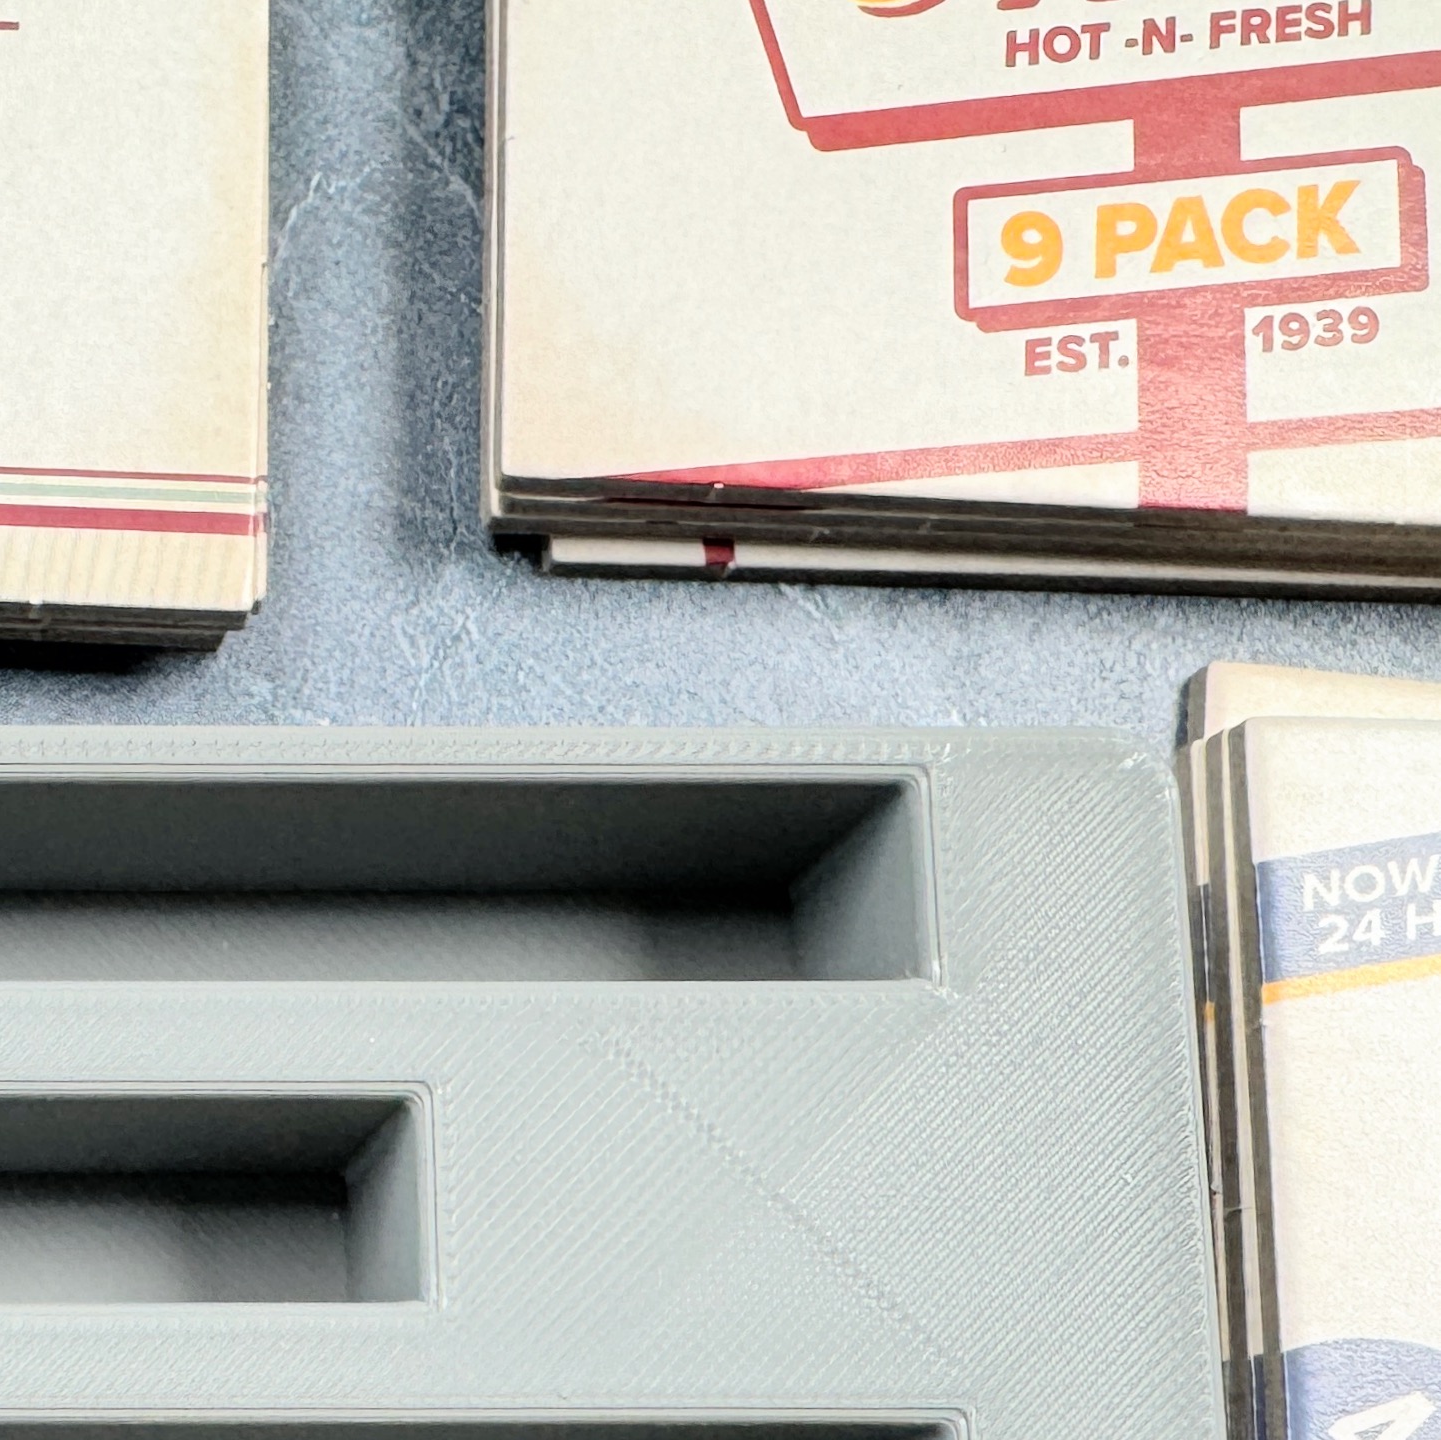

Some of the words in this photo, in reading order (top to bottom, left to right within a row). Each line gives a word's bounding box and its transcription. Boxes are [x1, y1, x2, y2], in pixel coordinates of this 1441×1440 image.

[1005, 22, 1111, 67] HOT
[1125, 16, 1193, 55] -N-
[1209, 0, 1372, 49] FRESH
[1001, 211, 1063, 287] 9
[1094, 180, 1362, 279] PACK
[1024, 329, 1129, 376] EST.
[1251, 306, 1379, 353] 1939
[1302, 854, 1441, 911] NOW
[1318, 909, 1385, 954] 24
